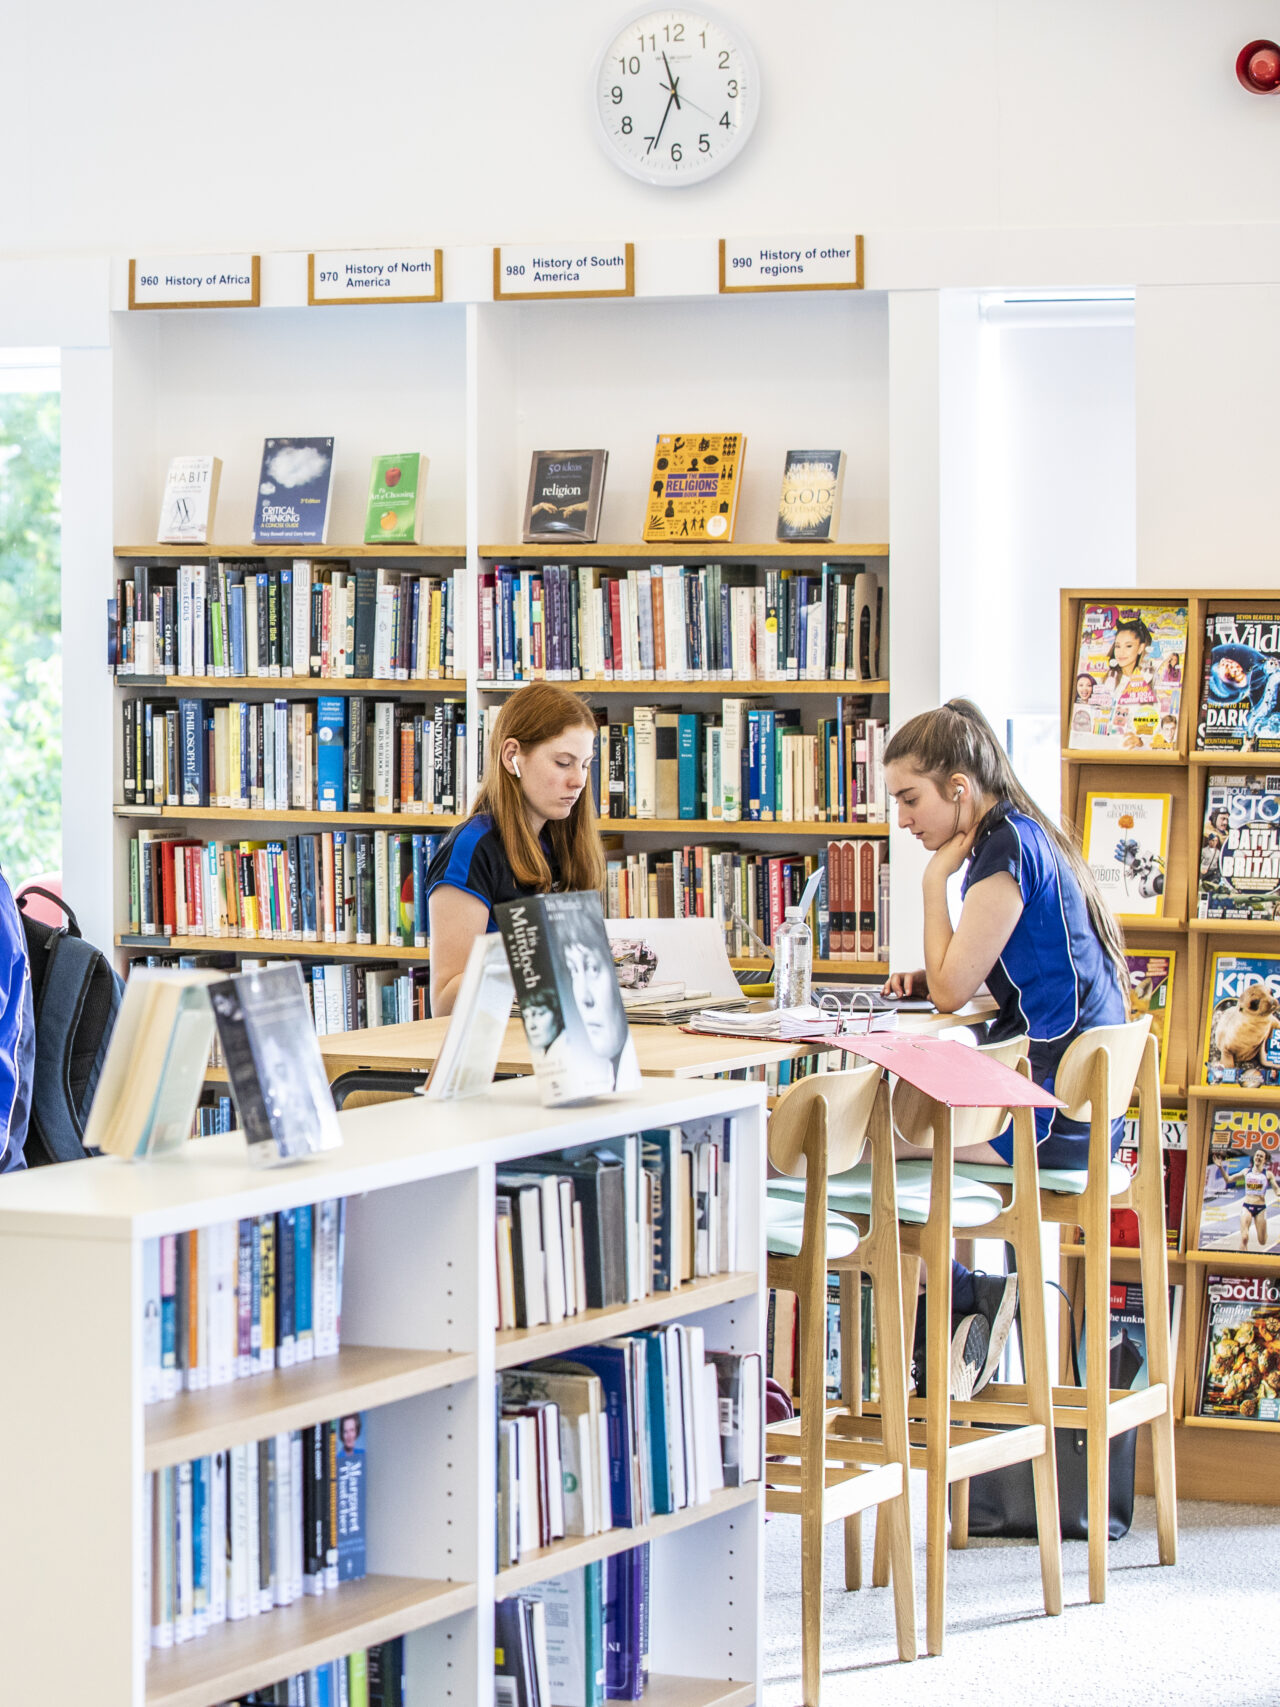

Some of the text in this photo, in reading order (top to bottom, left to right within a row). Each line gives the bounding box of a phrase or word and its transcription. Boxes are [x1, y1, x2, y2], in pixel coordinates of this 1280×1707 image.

[663, 23, 685, 43] 12
[698, 31, 706, 49] 1
[637, 34, 656, 52] 11
[619, 56, 641, 75] 10
[718, 51, 730, 69] 2
[611, 86, 623, 104] 9
[727, 80, 739, 98] 3
[621, 116, 633, 135] 8
[719, 111, 731, 130] 4
[643, 136, 656, 155] 7
[698, 134, 710, 152] 5
[671, 143, 682, 162] 6
[506, 256, 624, 276] 980 History of South
[732, 247, 851, 268] 990 History of other
[319, 261, 432, 282] 970 History of North
[533, 271, 580, 282] America
[760, 263, 804, 276] regions
[140, 274, 251, 288] 960 History of Africa
[346, 276, 391, 288] America
[169, 471, 208, 483] HABIT
[665, 480, 719, 492] RELIGIONS
[542, 483, 581, 499] religion
[784, 488, 831, 504] GOD
[261, 514, 300, 523] THINKING
[262, 506, 295, 515] CRITICAL
[1207, 708, 1249, 727] DARK
[185, 711, 196, 771] PHILOSOPHY
[434, 706, 443, 770] MINDWAVES
[1112, 803, 1144, 811] NATIONAL
[335, 875, 343, 907] PACKAGE
[526, 925, 538, 947] Iris
[509, 906, 541, 989] Murdoch
[1213, 1303, 1254, 1316] Comfort
[338, 1461, 349, 1535] Thatcher
[348, 1460, 362, 1532] Margaret
